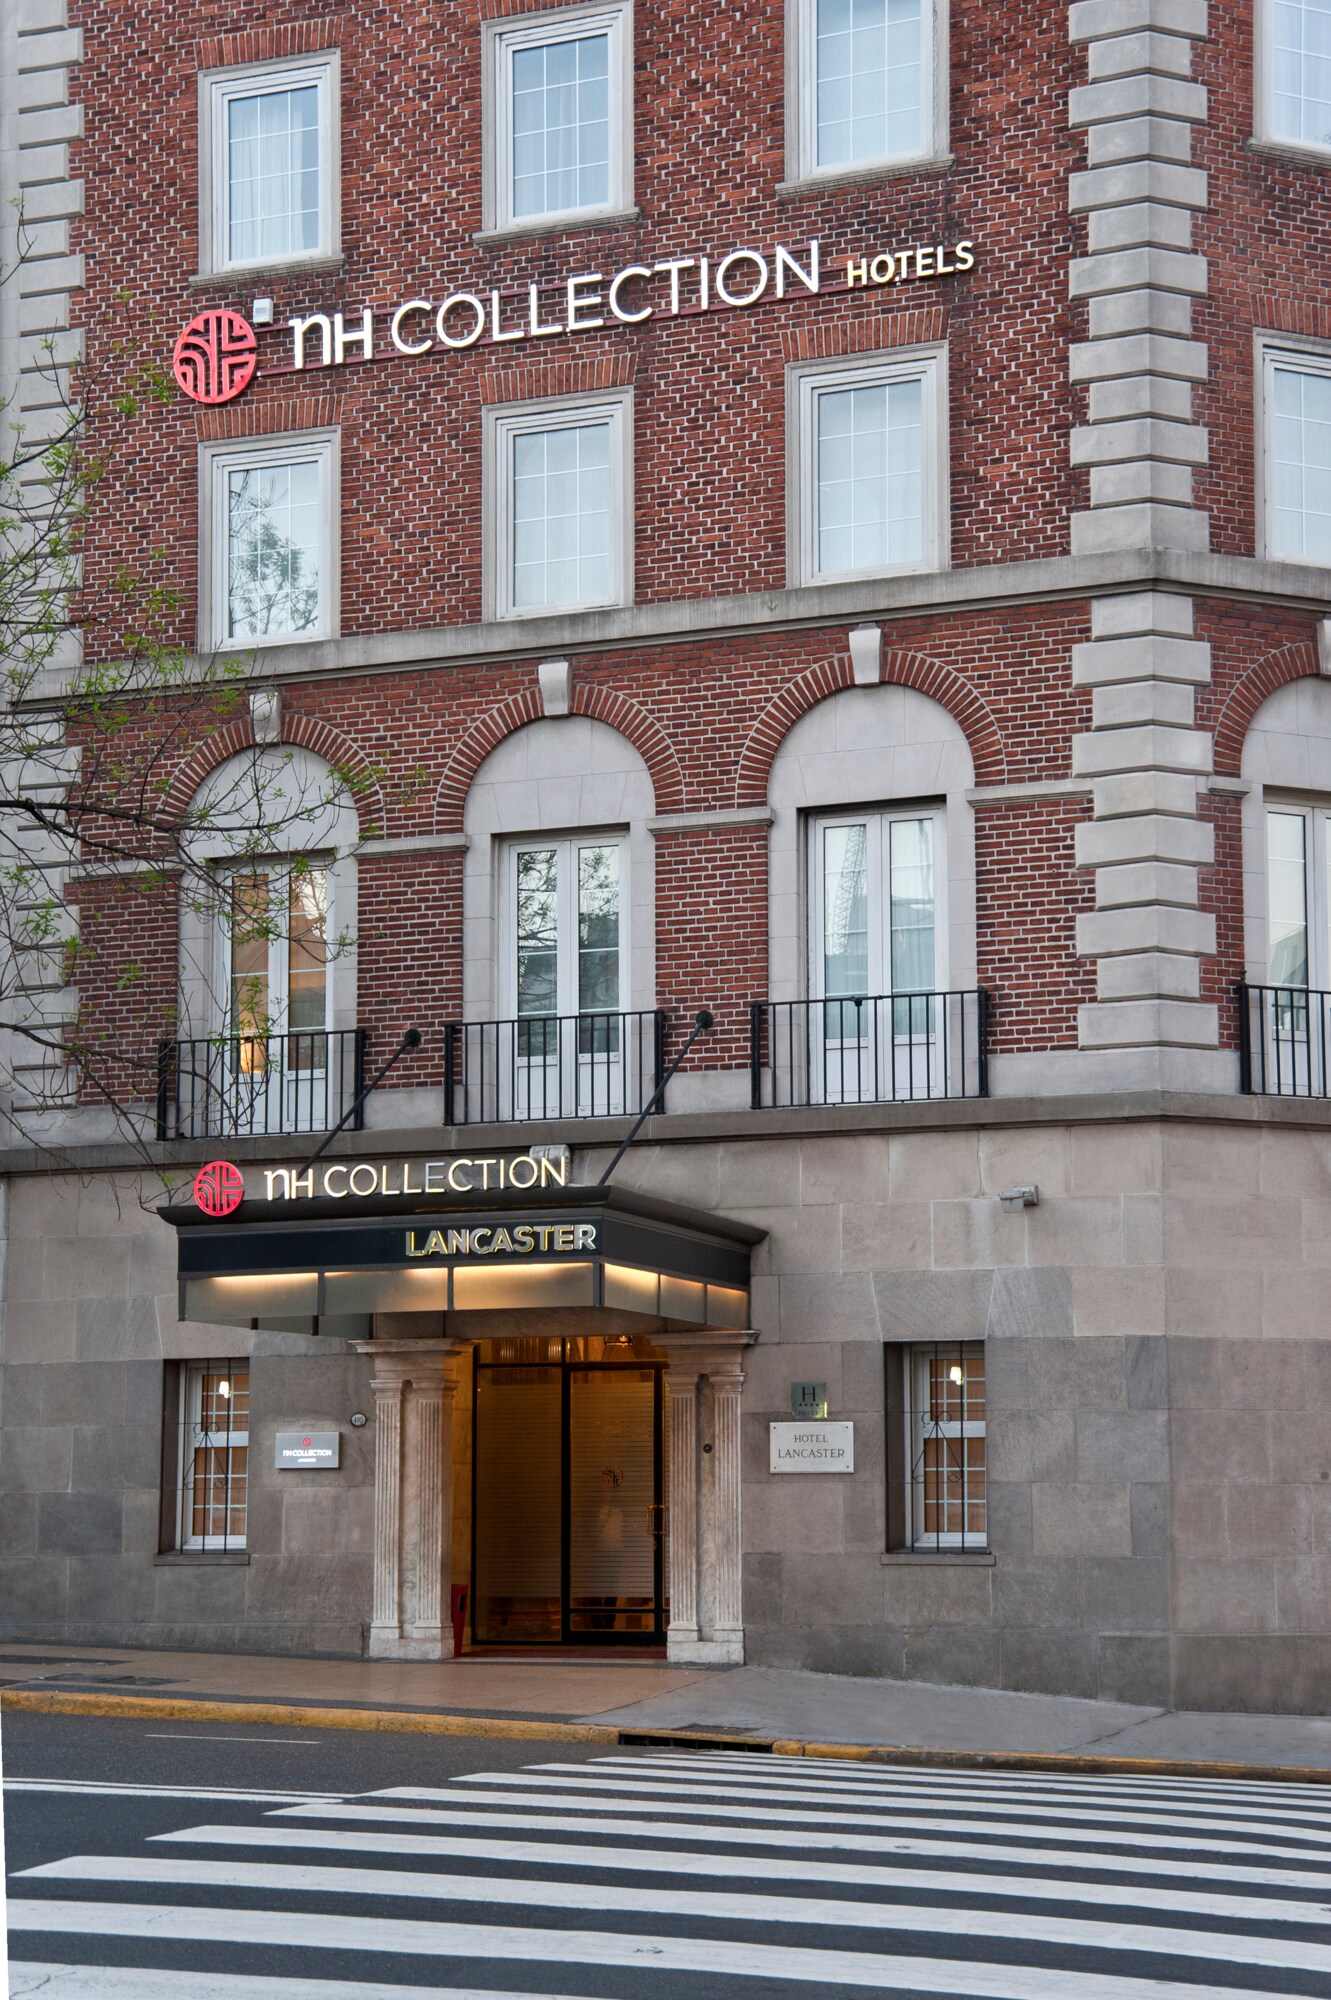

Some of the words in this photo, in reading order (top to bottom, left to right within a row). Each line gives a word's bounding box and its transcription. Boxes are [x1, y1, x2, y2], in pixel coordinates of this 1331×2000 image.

[391, 239, 820, 355] COLLECTION
[847, 240, 975, 289] HOTELS
[323, 1155, 567, 1199] COLLECTION
[405, 1223, 598, 1258] LANCASTER
[802, 1386, 816, 1402] H
[794, 1434, 829, 1443] HOTEL
[292, 1449, 332, 1457] COLLECTION
[778, 1448, 846, 1459] LANCASTER
